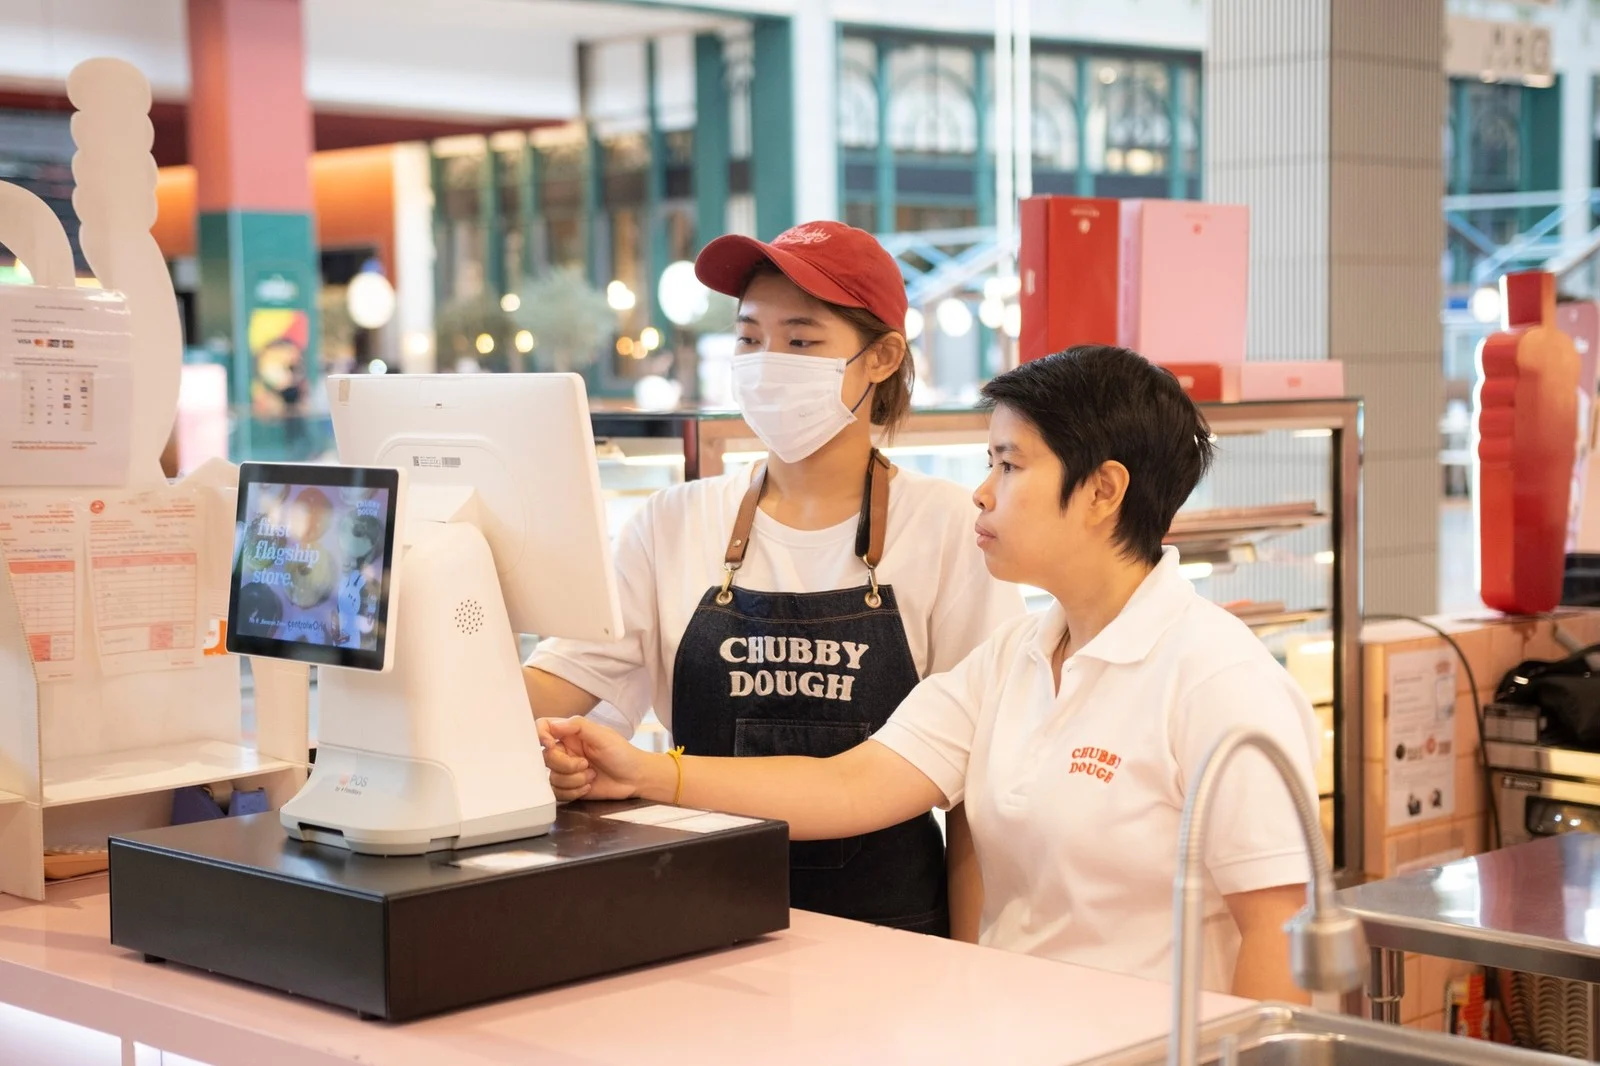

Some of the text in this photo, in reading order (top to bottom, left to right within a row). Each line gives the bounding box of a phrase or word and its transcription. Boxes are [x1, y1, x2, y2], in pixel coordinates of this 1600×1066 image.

[257, 518, 290, 537] first
[254, 540, 319, 568] flagship
[252, 569, 294, 587] store.
[719, 636, 869, 669] CHUBBY
[729, 670, 855, 701] DOUGH
